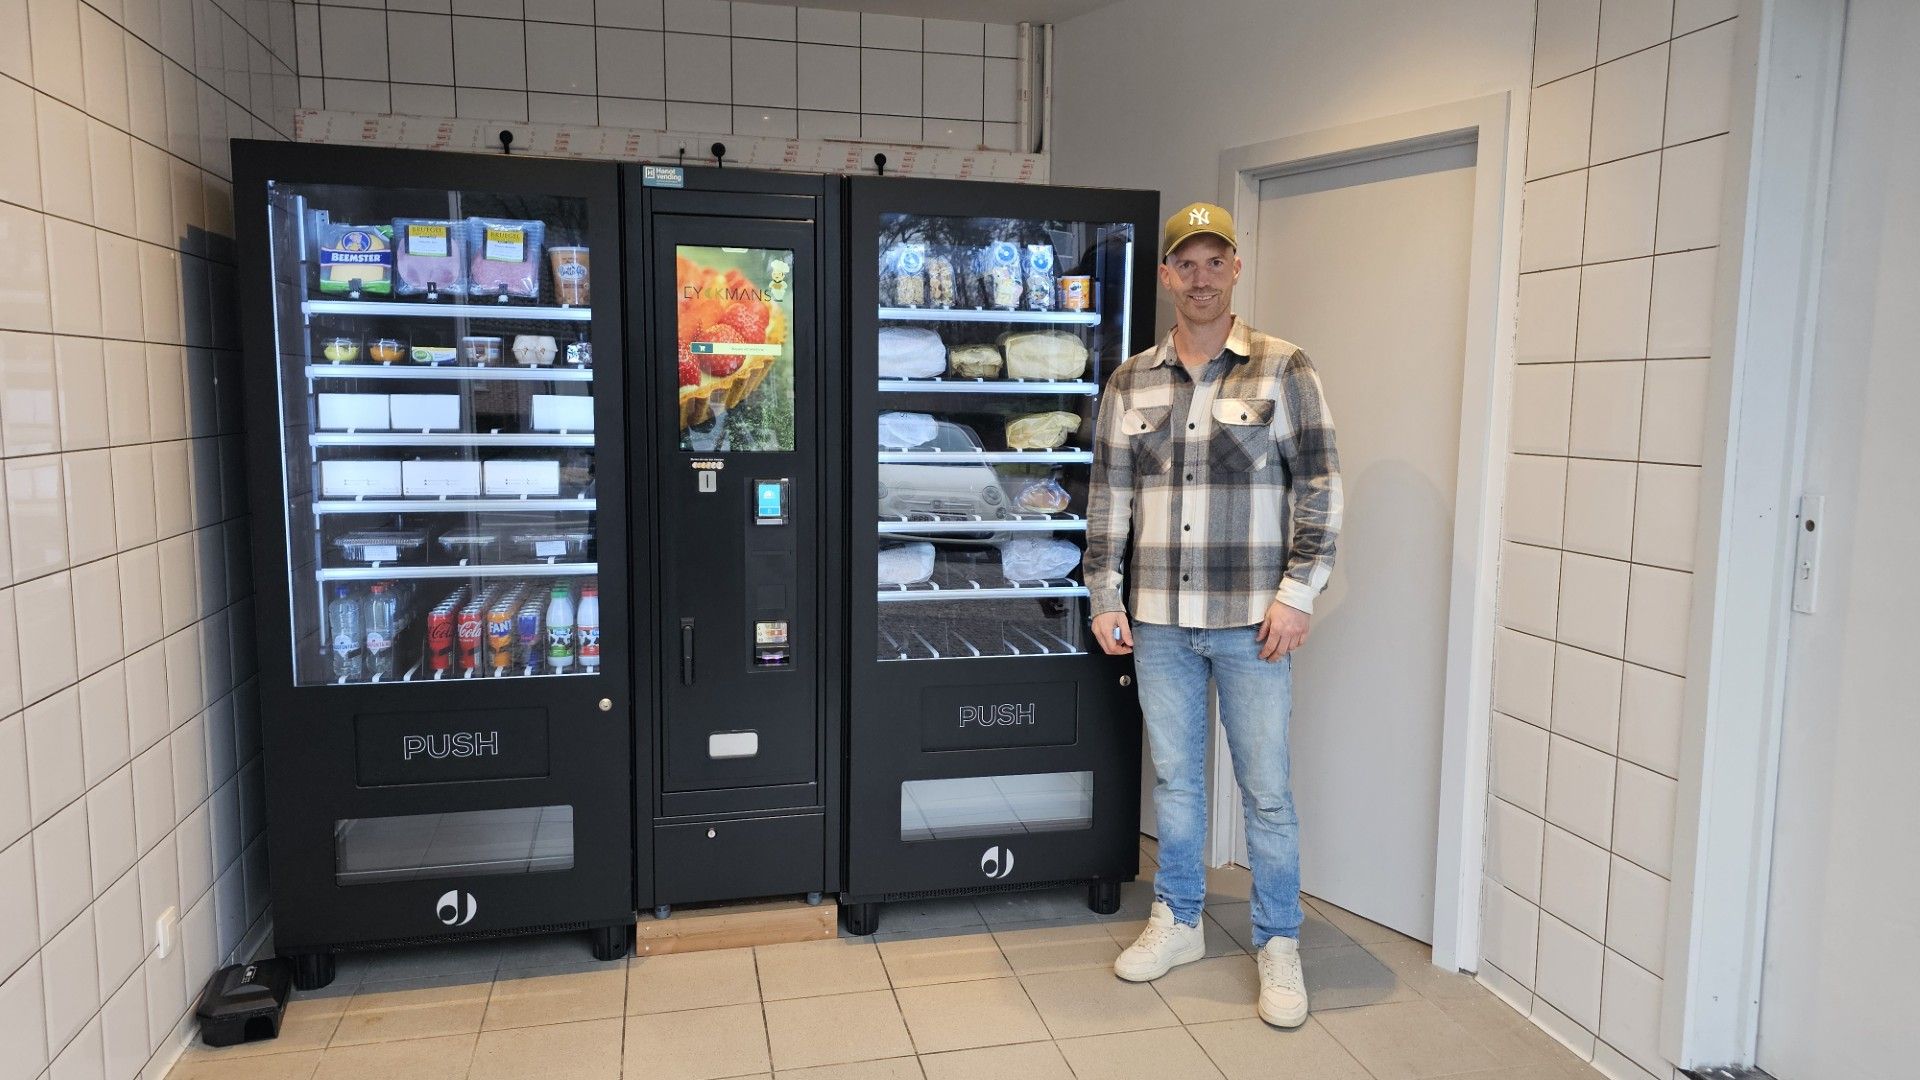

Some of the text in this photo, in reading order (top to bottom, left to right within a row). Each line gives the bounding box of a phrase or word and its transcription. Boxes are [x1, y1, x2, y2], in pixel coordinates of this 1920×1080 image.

[1188, 207, 1210, 226] NY
[331, 252, 381, 262] BEEMSTER
[959, 703, 1036, 728] PUSH
[403, 731, 499, 760] PUSH
